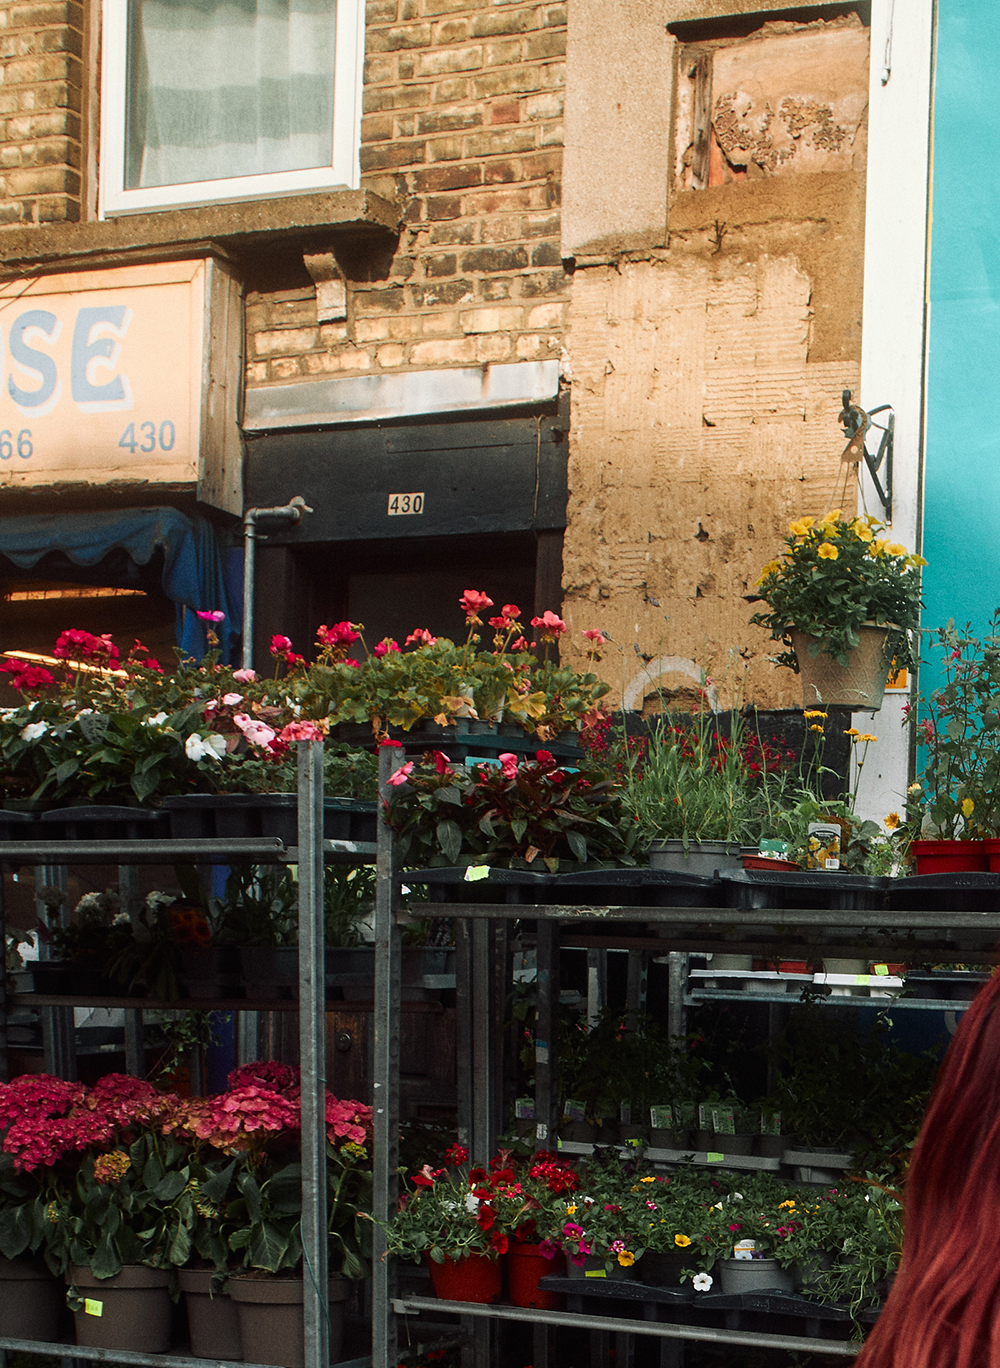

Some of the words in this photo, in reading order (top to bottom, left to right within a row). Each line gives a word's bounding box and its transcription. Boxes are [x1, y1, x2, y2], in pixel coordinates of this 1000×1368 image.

[0, 305, 134, 418] SE
[118, 420, 175, 454] 430
[390, 495, 422, 513] 430
